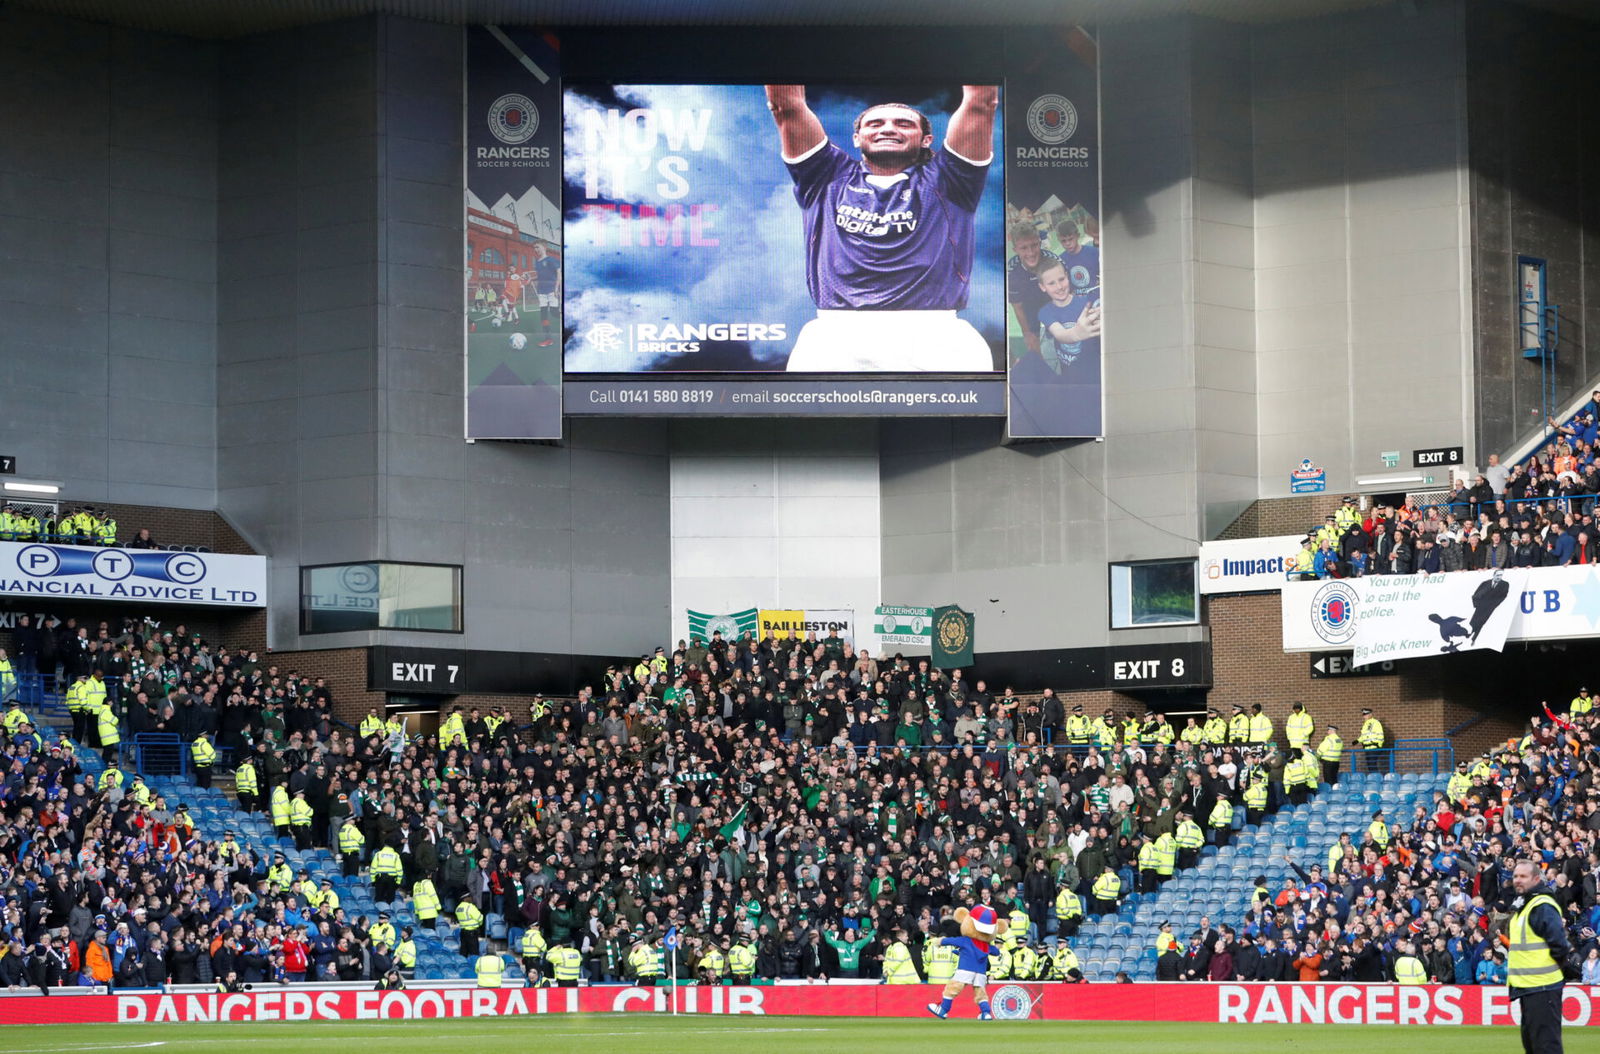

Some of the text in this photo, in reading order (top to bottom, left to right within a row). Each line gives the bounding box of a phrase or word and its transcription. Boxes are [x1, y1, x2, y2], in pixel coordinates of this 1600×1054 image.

[584, 108, 712, 151] NOW
[476, 147, 550, 159] RANGERS
[1016, 147, 1089, 159] RANGERS
[582, 203, 719, 247] TIME
[891, 219, 917, 233] TV
[637, 323, 786, 341] RANGERS
[637, 342, 700, 353] BRICKS
[589, 390, 978, 407] Call 0141 580 8819 email soccerschools@rangers.co.uk
[3, 459, 10, 470] 7
[1418, 450, 1458, 464] EXIT 8
[1369, 576, 1391, 587] You
[1393, 575, 1419, 587] only
[1378, 591, 1399, 603] call
[1402, 590, 1421, 602] the
[881, 607, 928, 615] EASTERHOUSE
[34, 613, 46, 630] 7
[763, 620, 848, 631] BAILLIESTON
[1355, 639, 1432, 658] Big Jock Knew
[392, 662, 459, 683] EXIT 7
[1114, 658, 1185, 680] EXIT 8
[117, 993, 342, 1023] RANGERS
[1218, 984, 1464, 1025] RANGERS
